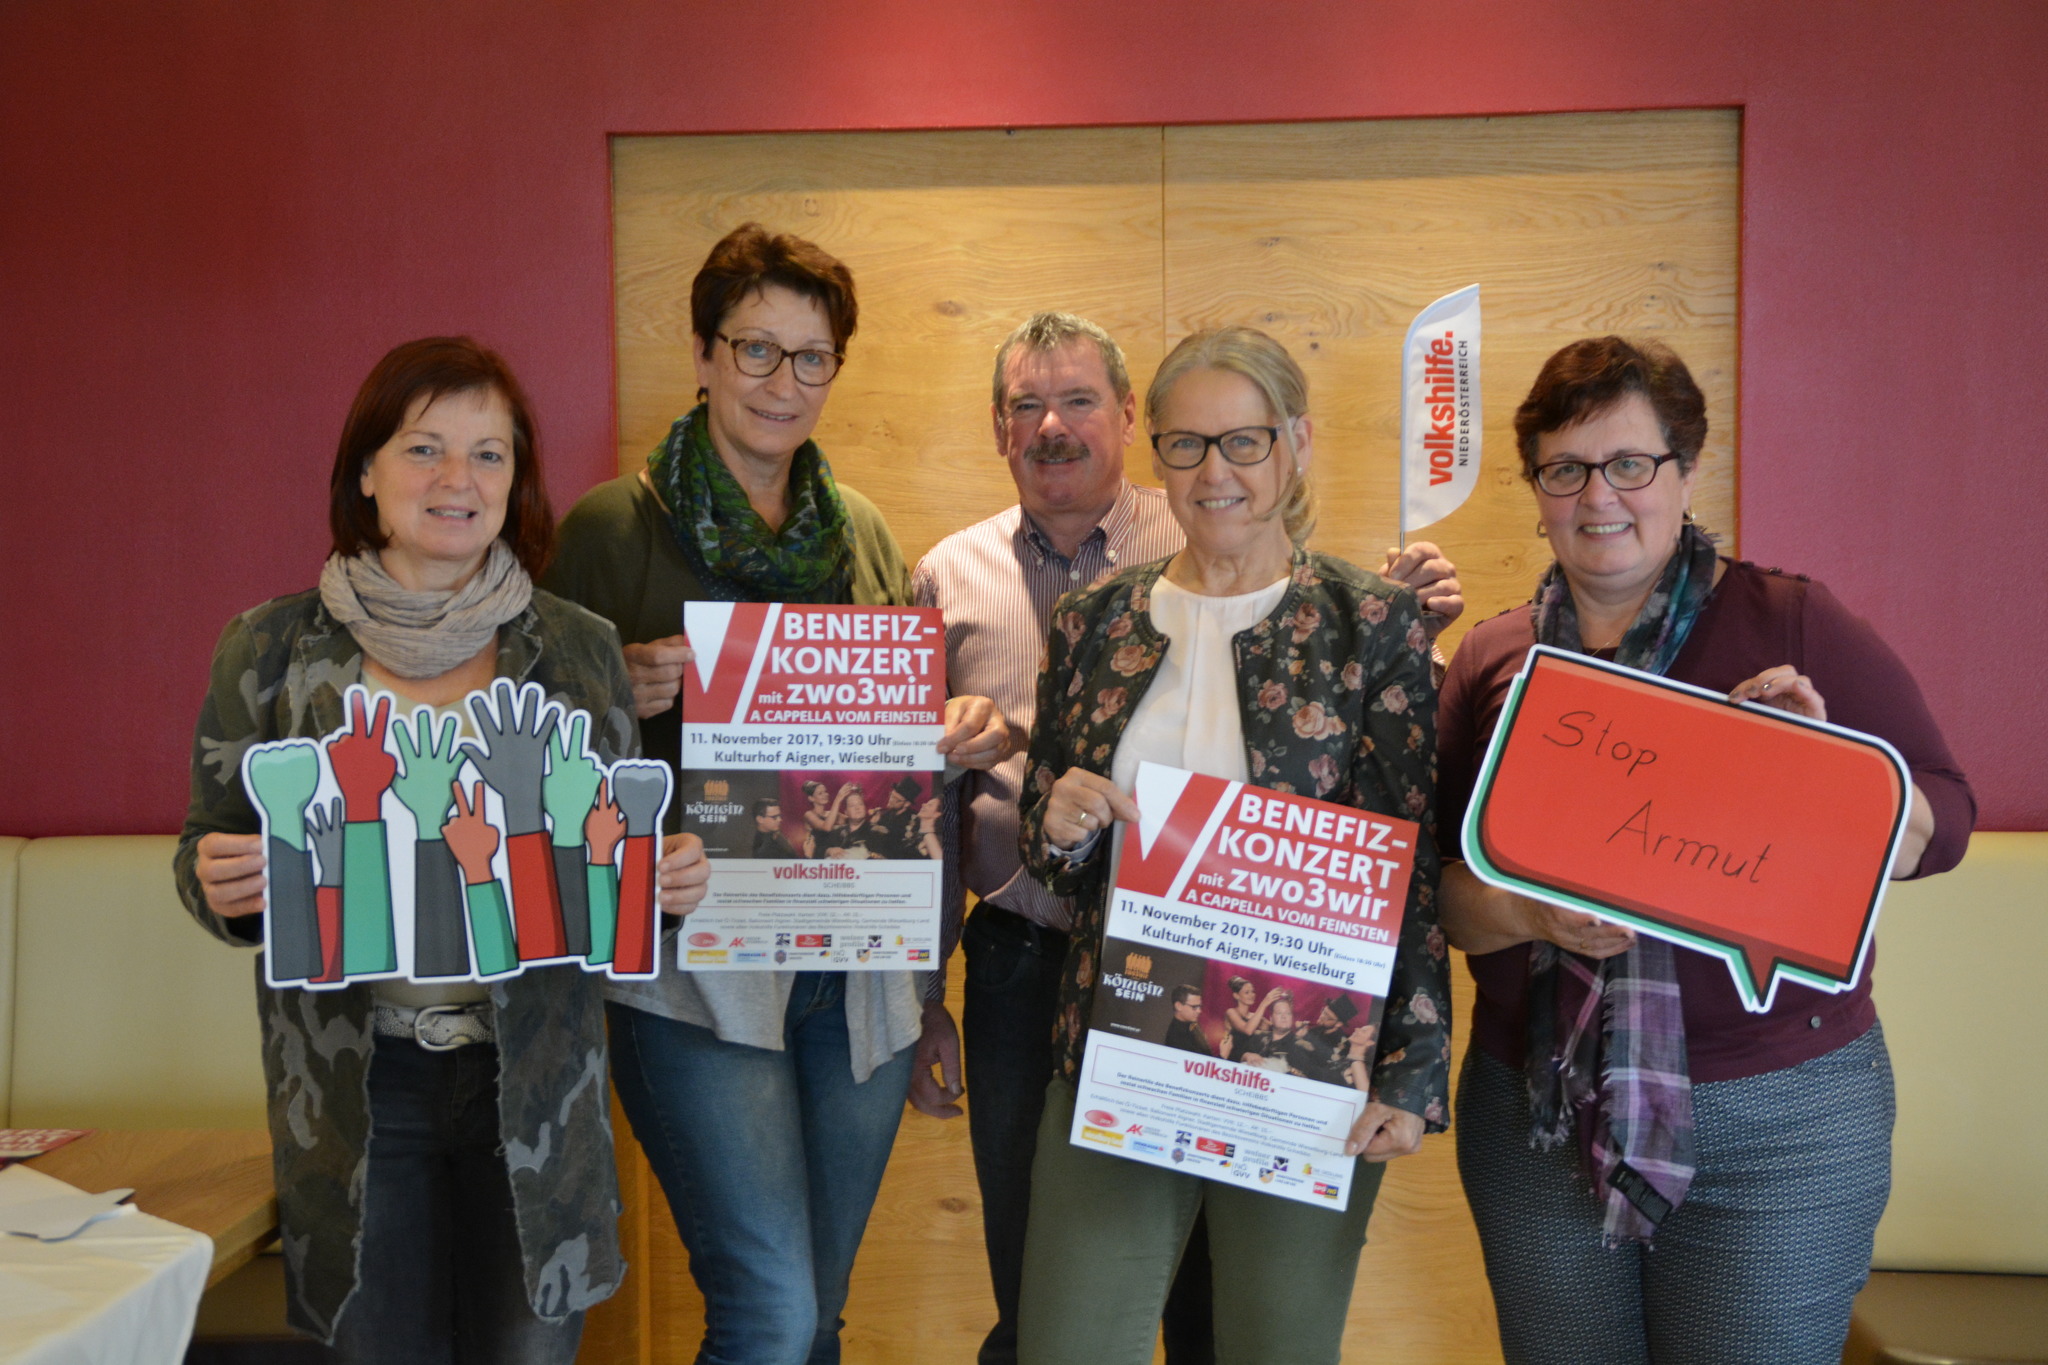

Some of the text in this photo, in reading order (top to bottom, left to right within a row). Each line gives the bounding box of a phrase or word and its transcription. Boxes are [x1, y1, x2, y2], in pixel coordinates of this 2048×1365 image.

[1424, 330, 1456, 487] volkshilfe.
[1458, 340, 1470, 467] NIEDERÖSTERREICH
[784, 612, 937, 642] BENEFIZ-
[771, 646, 935, 676] KONZERT
[758, 675, 932, 706] mit zwo3wir
[750, 709, 937, 723] A CAPPELLA VOM FEINSTEN
[690, 732, 708, 745] 11.
[712, 733, 783, 746] November
[787, 734, 824, 748] 2017,
[827, 734, 864, 746] 19:30
[867, 734, 892, 746] Uhr
[714, 750, 915, 767] Kulturhof Aigner, Wieselburg
[1542, 710, 1658, 777] Stop
[699, 815, 728, 823] SEIN
[1238, 793, 1408, 853] BENEFIZ-
[1217, 825, 1400, 889] KONZERT
[1605, 800, 1772, 884] Armut
[773, 863, 860, 880] volkshilfe.
[1186, 889, 1390, 943] A CAPPELLA VOM FEINSTEN
[1198, 867, 1389, 922] mit zwo3wir
[1120, 899, 1138, 915] 11.
[1141, 904, 1217, 932] November
[1221, 921, 1259, 944] 2017,
[1264, 931, 1304, 951] 19:30
[1308, 941, 1335, 959] Uhr
[1141, 924, 1356, 985] Kulturhof Aigner, Wieselburg
[1115, 987, 1146, 1002] SEIN
[1184, 1059, 1276, 1094] volkshilfe.
